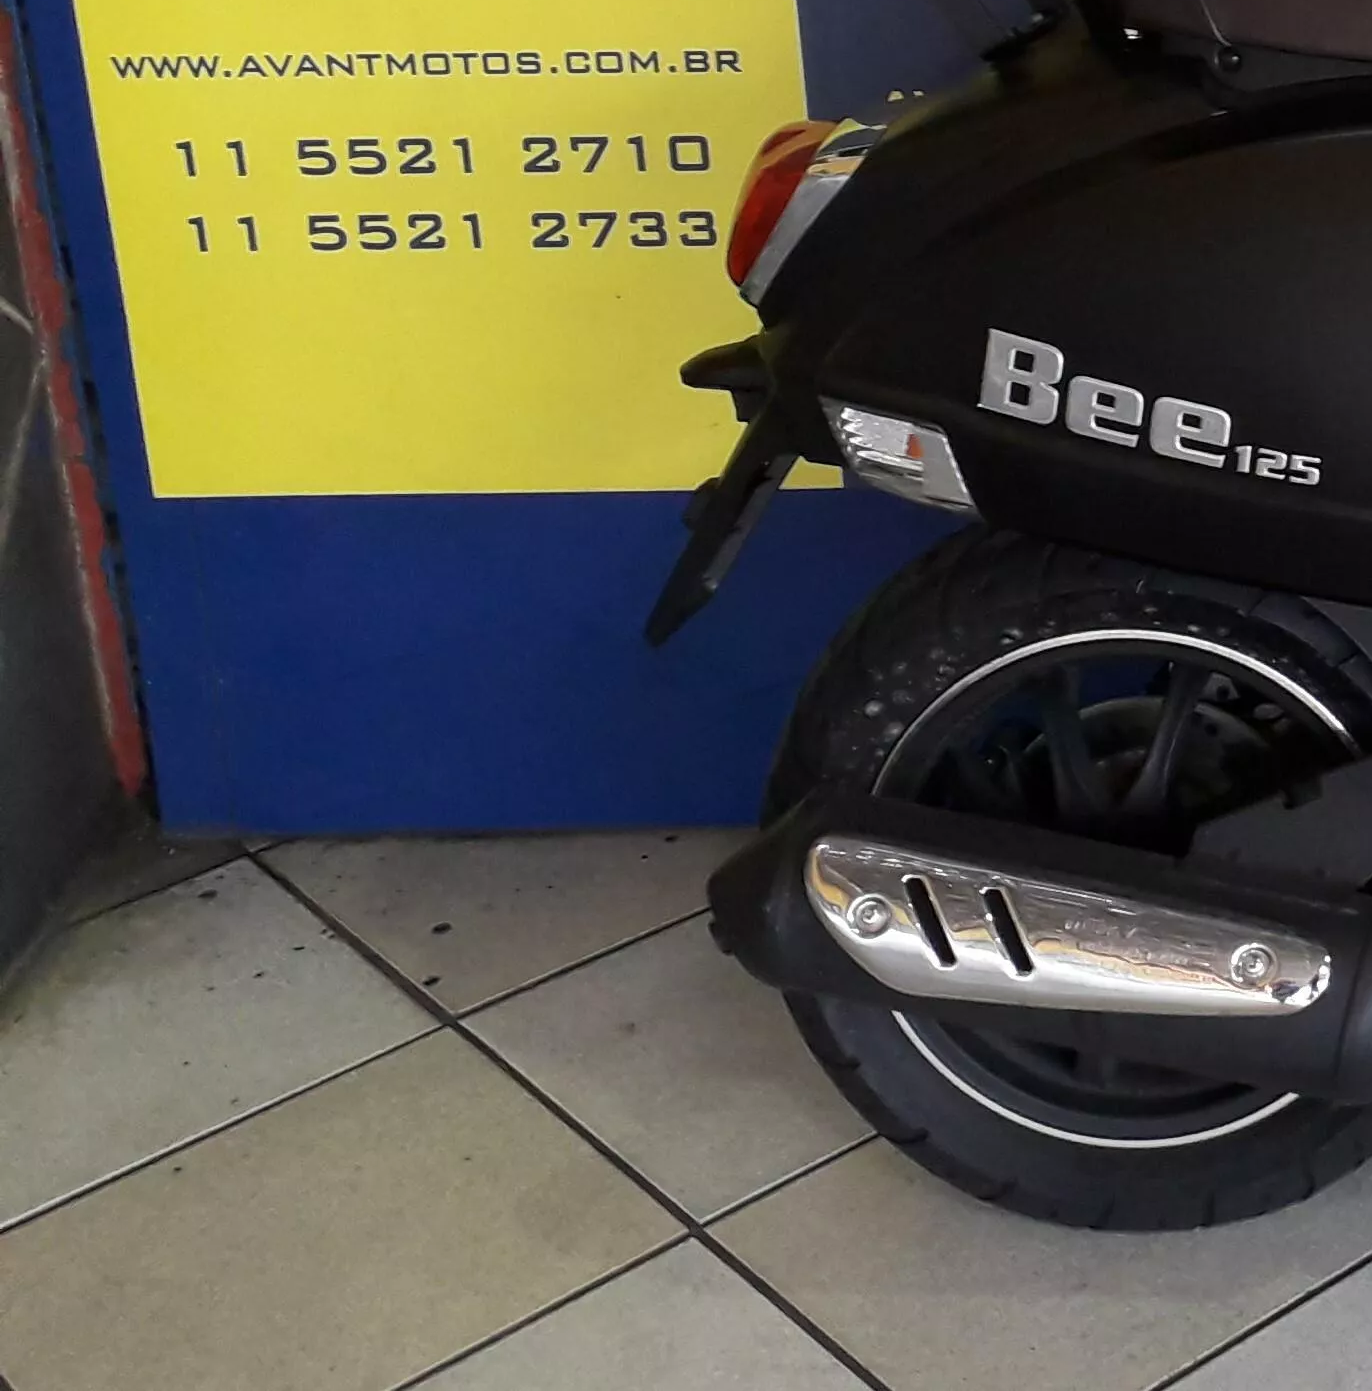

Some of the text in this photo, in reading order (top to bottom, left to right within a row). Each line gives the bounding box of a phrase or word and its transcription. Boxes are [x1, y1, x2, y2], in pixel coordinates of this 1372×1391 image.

[108, 49, 744, 80] WWW.AVANTMOTOS.COM.BR
[174, 134, 712, 178] 11 5521 2710
[187, 210, 719, 253] 11 5521 2733
[976, 327, 1323, 487] Bee 125
